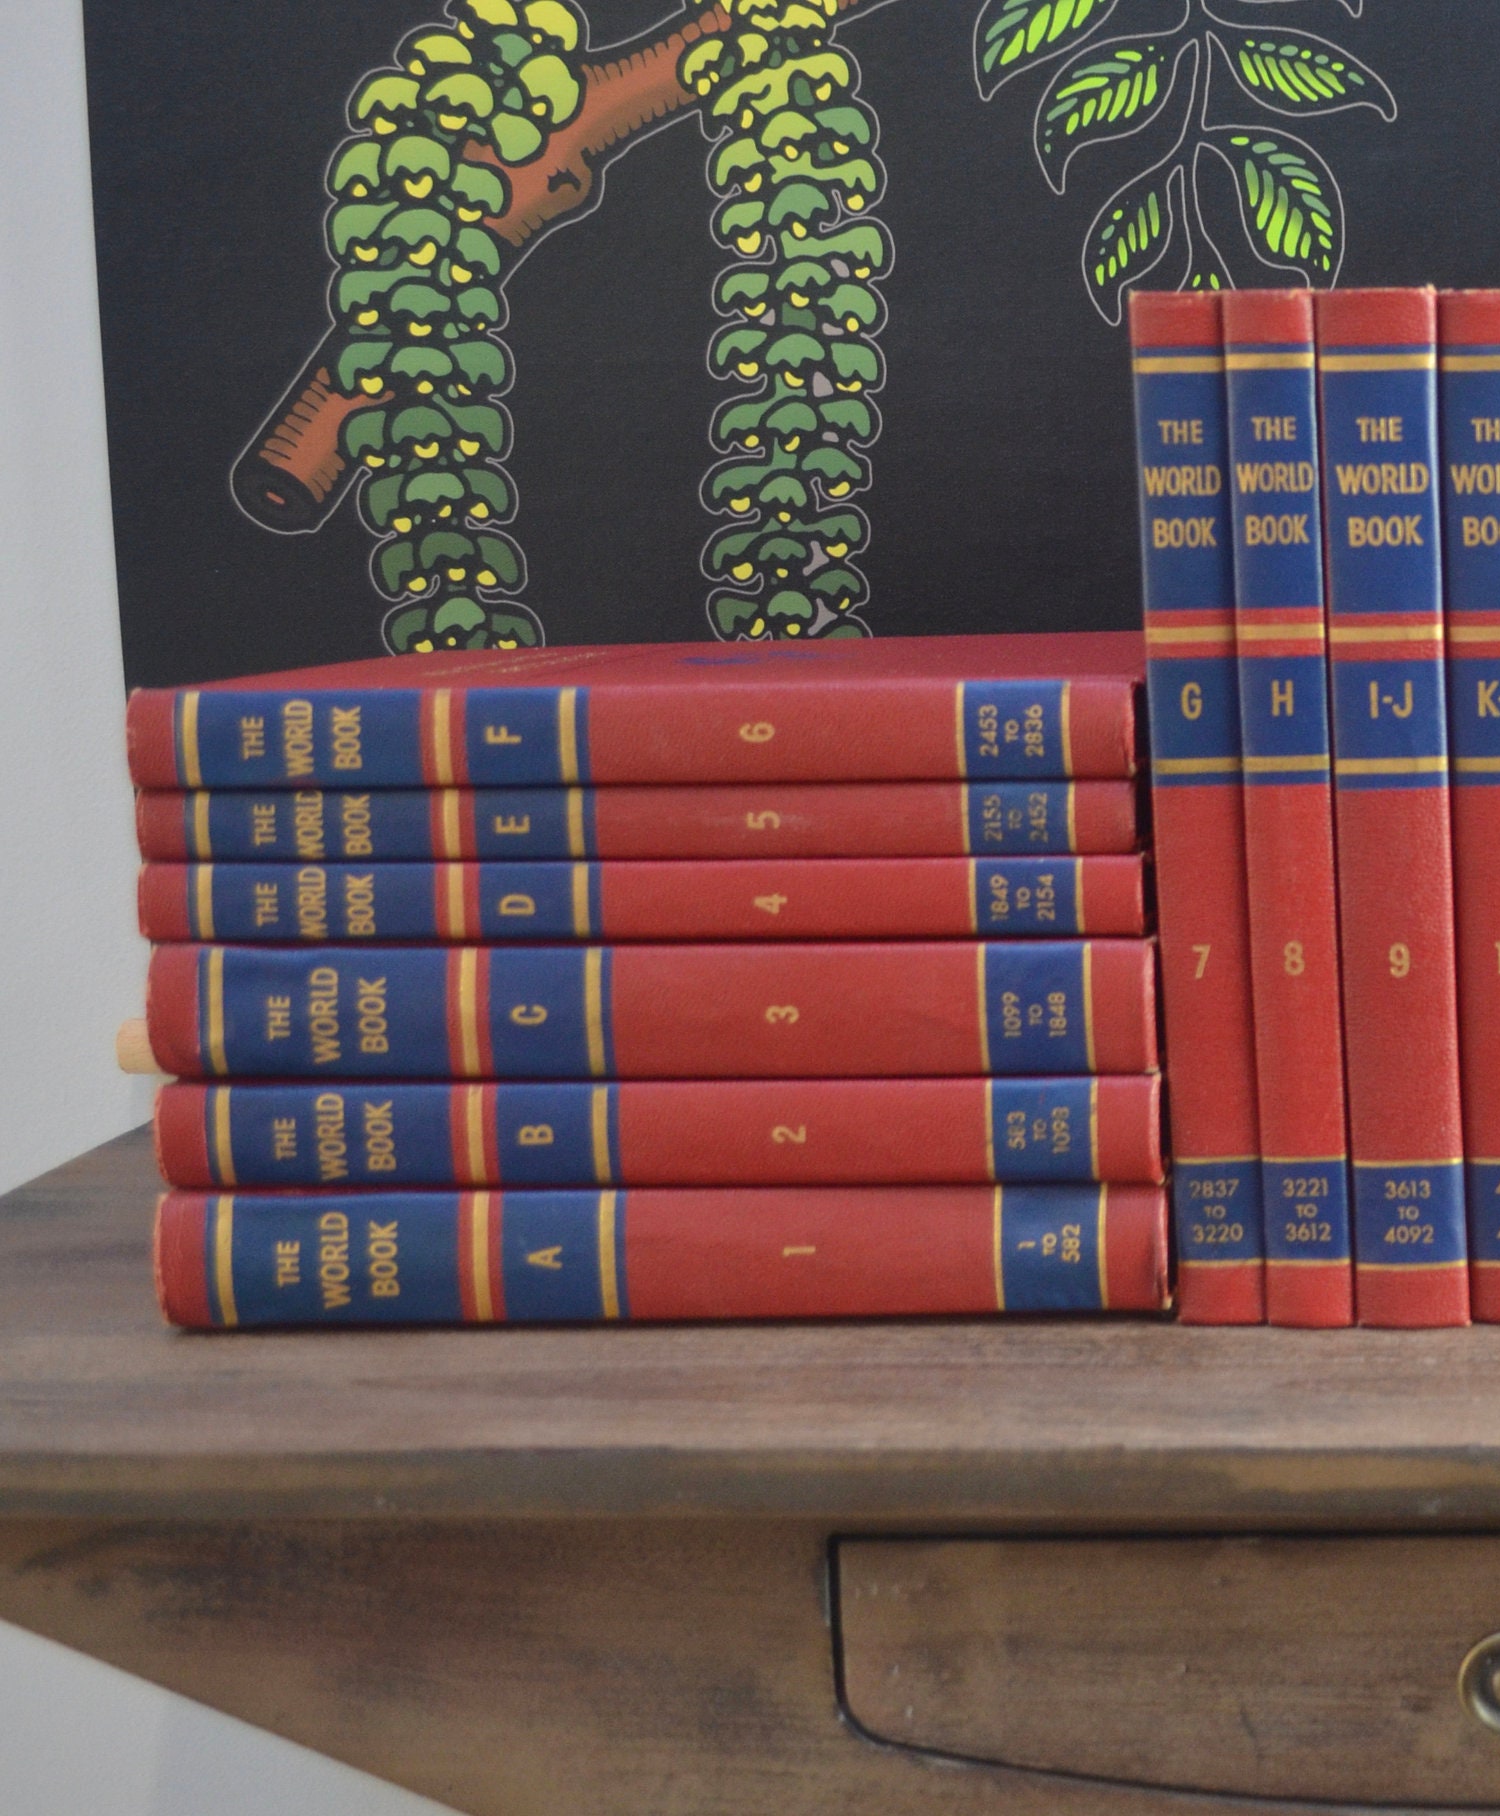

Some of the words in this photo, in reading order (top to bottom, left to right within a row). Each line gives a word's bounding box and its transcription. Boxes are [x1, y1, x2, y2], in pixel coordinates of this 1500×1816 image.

[1159, 420, 1203, 444] THE
[1252, 417, 1296, 441] THE
[1357, 417, 1403, 442] THE
[1145, 465, 1221, 496] WORLD
[1237, 461, 1314, 493] WORLD
[1337, 463, 1428, 495] WORLD
[1153, 518, 1217, 549] BOOK
[1246, 514, 1310, 546] BOOK
[1349, 515, 1423, 547] BOOK
[1182, 682, 1201, 719] G
[1272, 681, 1293, 717] H
[1370, 682, 1413, 718] I-J
[244, 715, 264, 759] THE
[286, 699, 312, 777] WORLD
[334, 705, 360, 770] BOOK
[487, 725, 521, 744] F
[740, 721, 775, 742] 6
[980, 704, 998, 757] 2453
[1006, 720, 1018, 743] TO
[1025, 704, 1042, 757] 2836
[255, 804, 275, 847] THE
[344, 794, 372, 855] BOOK
[497, 816, 529, 834] E
[747, 811, 780, 830] 5
[257, 882, 277, 926] THE
[300, 866, 326, 938] WORLD
[348, 874, 374, 935] BOOK
[501, 894, 534, 915] D
[755, 893, 787, 915] 4
[1017, 887, 1030, 909] TO
[1038, 873, 1055, 920] 2154
[1192, 945, 1211, 978] 7
[1284, 941, 1305, 975] 8
[1389, 943, 1411, 977] 9
[269, 995, 290, 1040] THE
[311, 966, 338, 1065] WORLD
[359, 976, 388, 1053] BOOK
[512, 1004, 546, 1025] C
[767, 1005, 800, 1025] 3
[1004, 992, 1021, 1038] 1099
[1049, 993, 1065, 1038] 1848
[275, 1117, 296, 1160] THE
[316, 1093, 346, 1181] WORLD
[367, 1100, 395, 1172] BOOK
[520, 1124, 553, 1145] B
[773, 1125, 806, 1144] 2
[1283, 1177, 1328, 1196] 3221
[1385, 1180, 1430, 1199] 3613
[1296, 1205, 1317, 1218] TO
[1398, 1206, 1418, 1220] TO
[1018, 1240, 1034, 1250] 1
[1043, 1234, 1056, 1256] TO
[1063, 1223, 1080, 1263] 582
[1193, 1224, 1242, 1242] 3220
[1285, 1223, 1331, 1241] 3612
[1384, 1225, 1434, 1243] 4092
[279, 1240, 300, 1285] THE
[321, 1212, 349, 1308] WORLD
[371, 1220, 399, 1298] BOOK
[528, 1246, 562, 1269] A
[783, 1245, 816, 1256] 1
